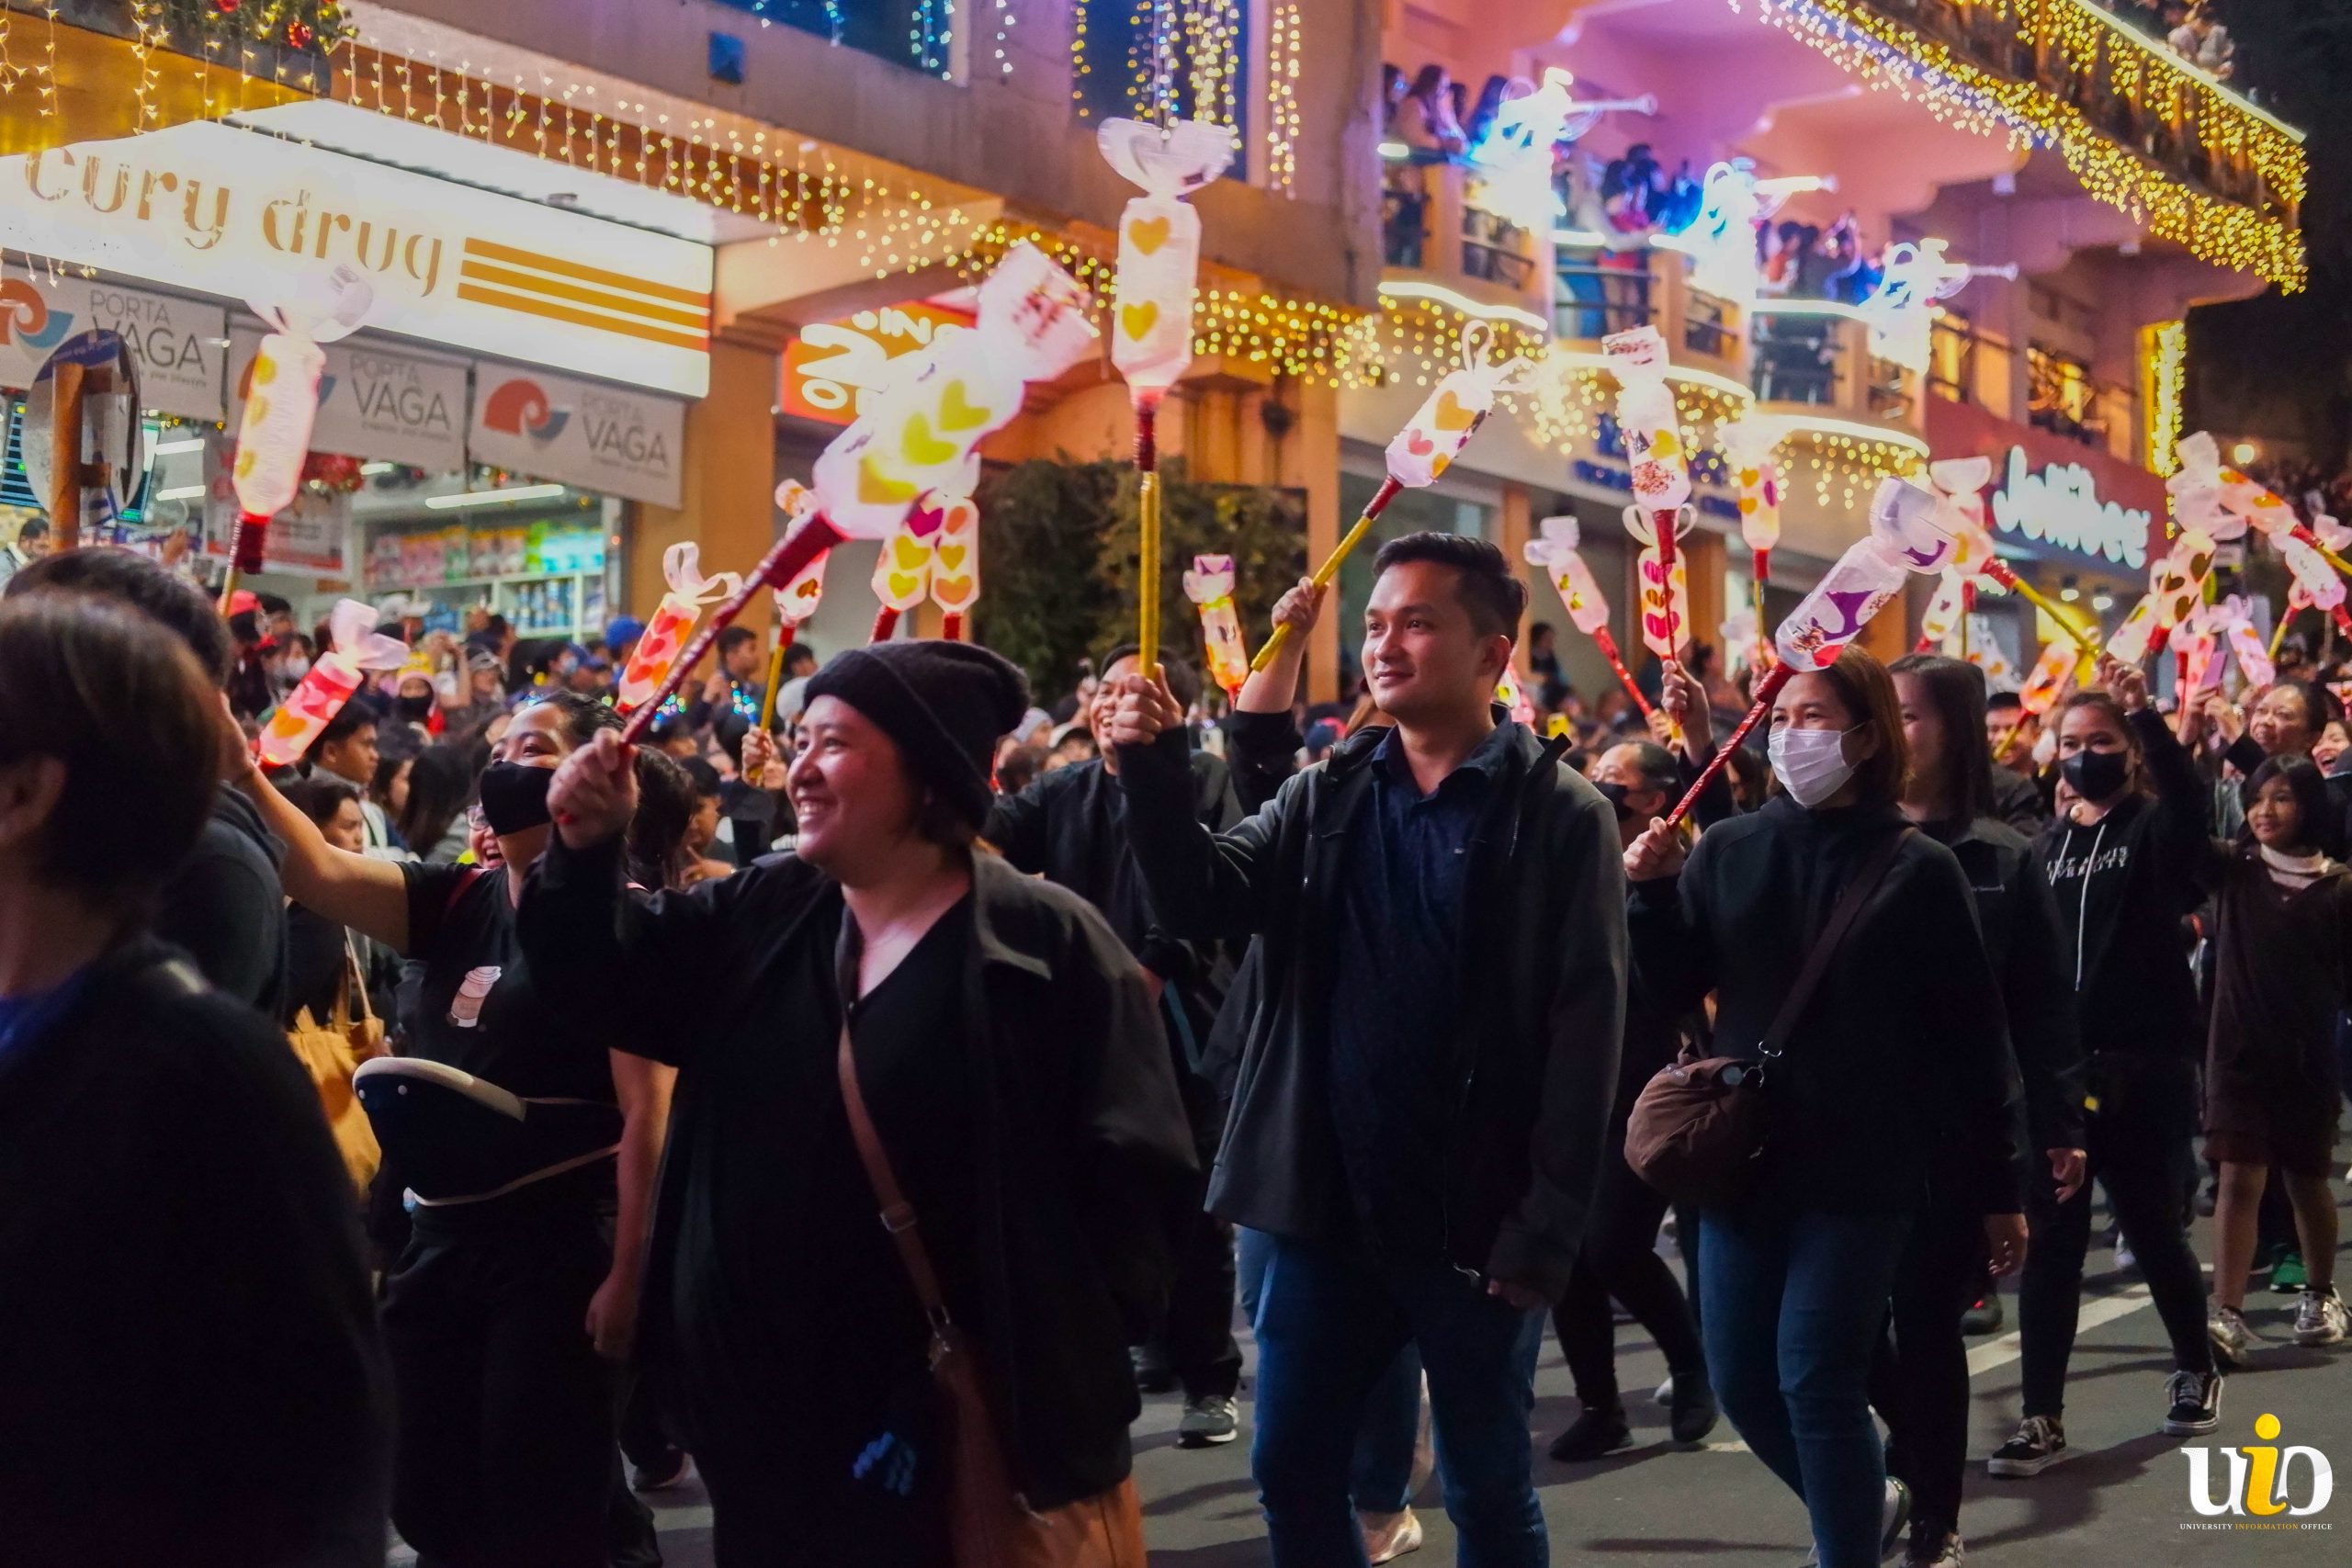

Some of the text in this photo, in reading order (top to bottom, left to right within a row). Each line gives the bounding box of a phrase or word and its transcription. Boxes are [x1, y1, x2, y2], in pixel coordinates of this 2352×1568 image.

[263, 189, 442, 298] drug
[90, 288, 170, 325] PORTA
[352, 377, 451, 432] VAGA
[582, 414, 670, 469] VAGA
